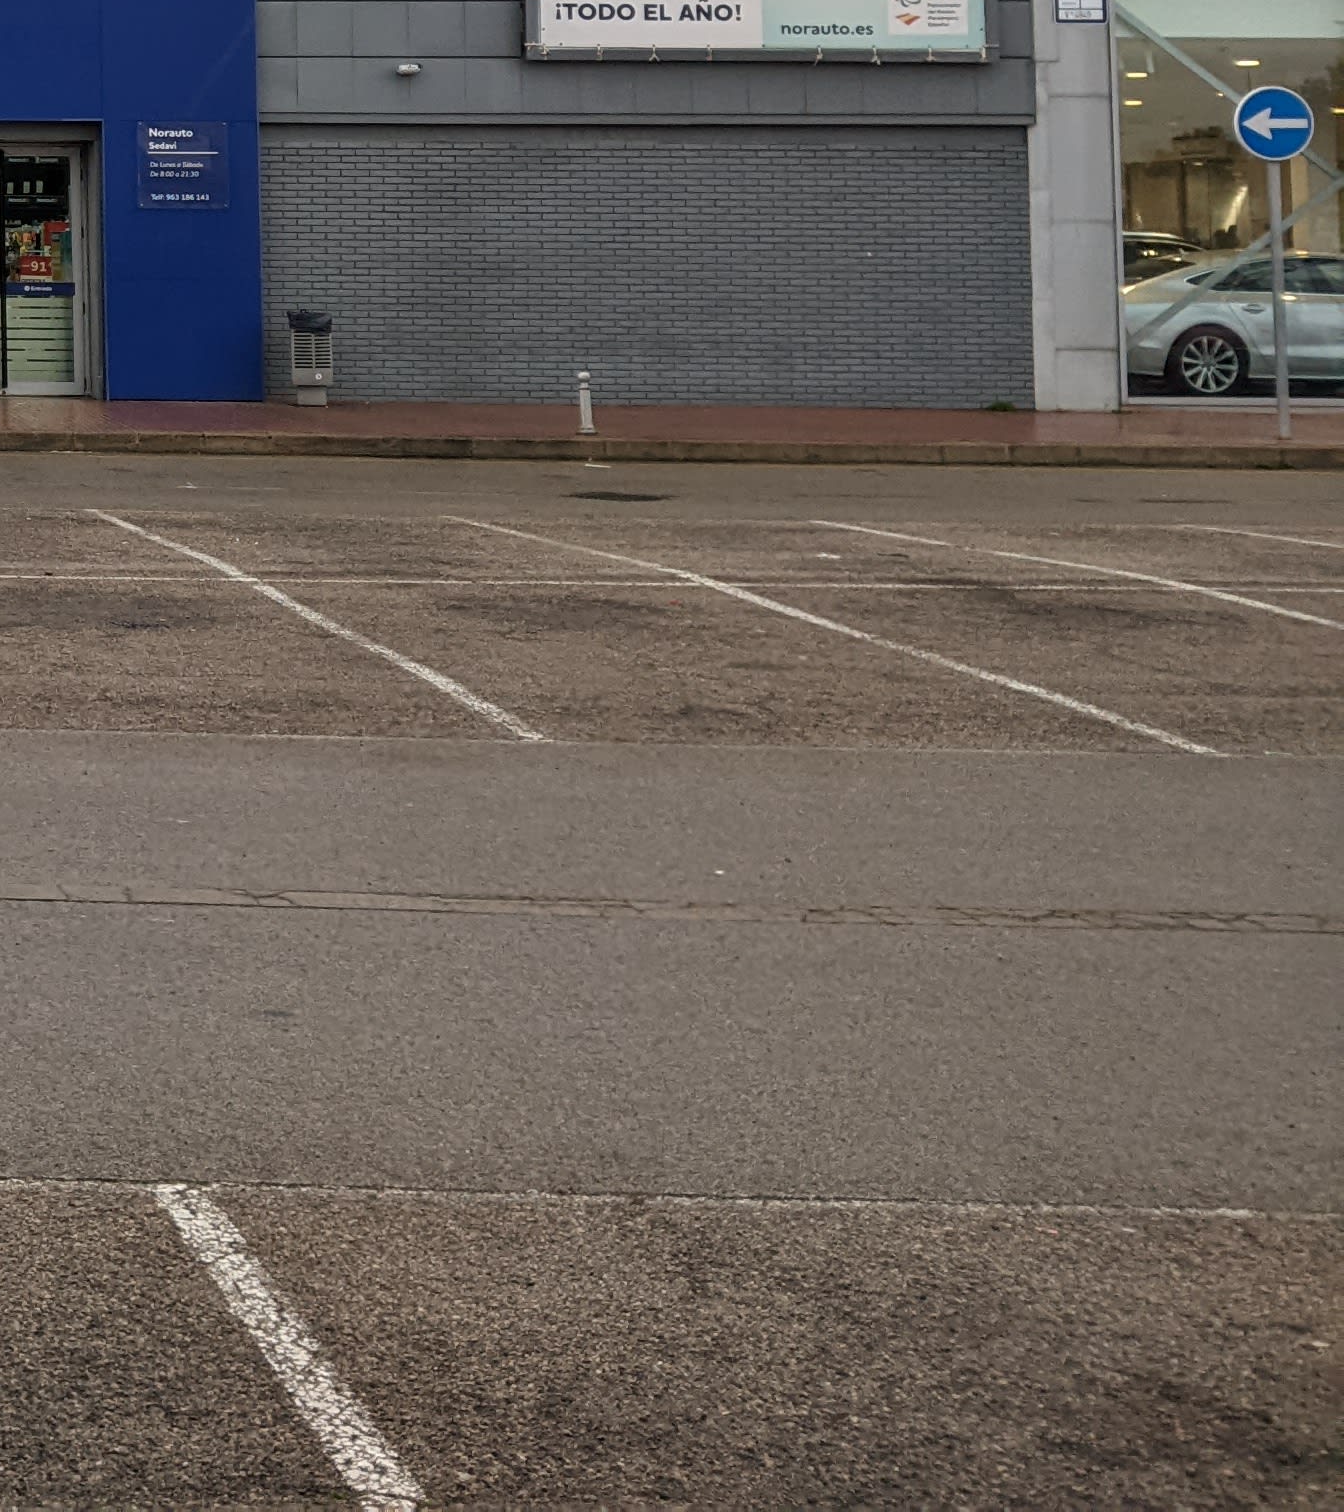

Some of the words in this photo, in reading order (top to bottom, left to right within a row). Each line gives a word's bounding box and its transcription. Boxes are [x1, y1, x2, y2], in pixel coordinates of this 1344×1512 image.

[555, 3, 636, 22] ¡TODO
[643, 3, 673, 22] EL
[781, 23, 874, 36] norauto.es
[149, 128, 193, 137] Norauto
